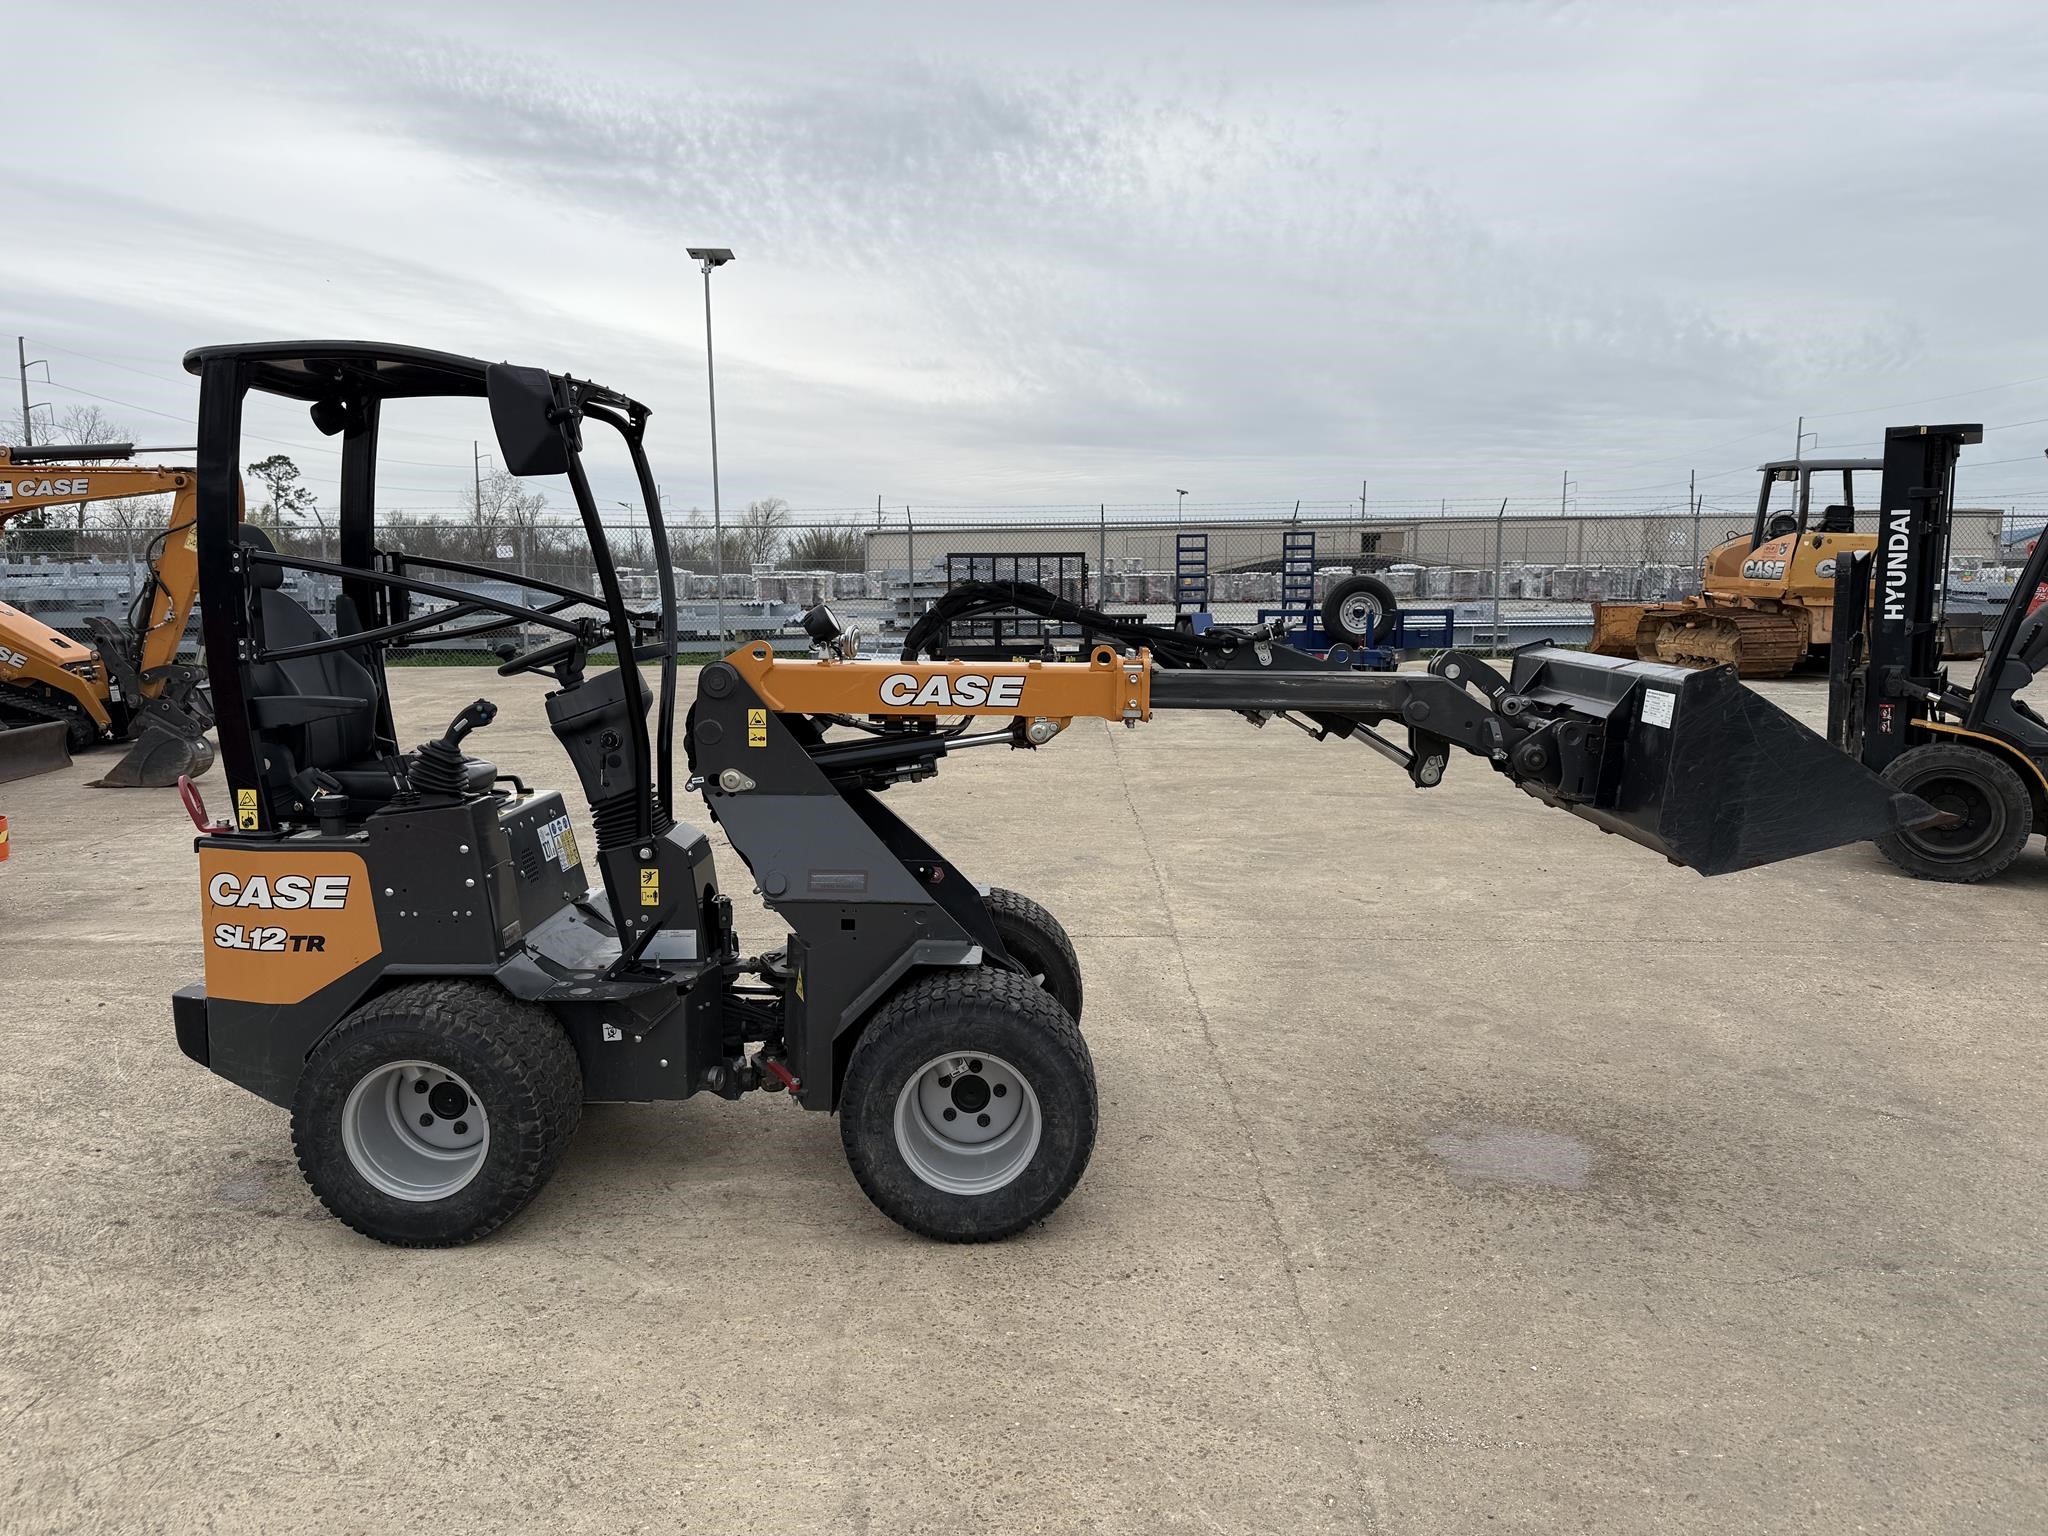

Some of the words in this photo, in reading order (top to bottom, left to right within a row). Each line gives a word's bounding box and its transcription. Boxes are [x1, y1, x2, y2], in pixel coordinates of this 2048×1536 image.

[16, 478, 89, 497] CASE
[1743, 560, 1786, 580] CASE
[1884, 509, 1911, 620] HYUNDAI
[879, 673, 1026, 708] CASE
[209, 872, 351, 910] CASE
[213, 923, 288, 952] SL12
[289, 935, 326, 952] TR
